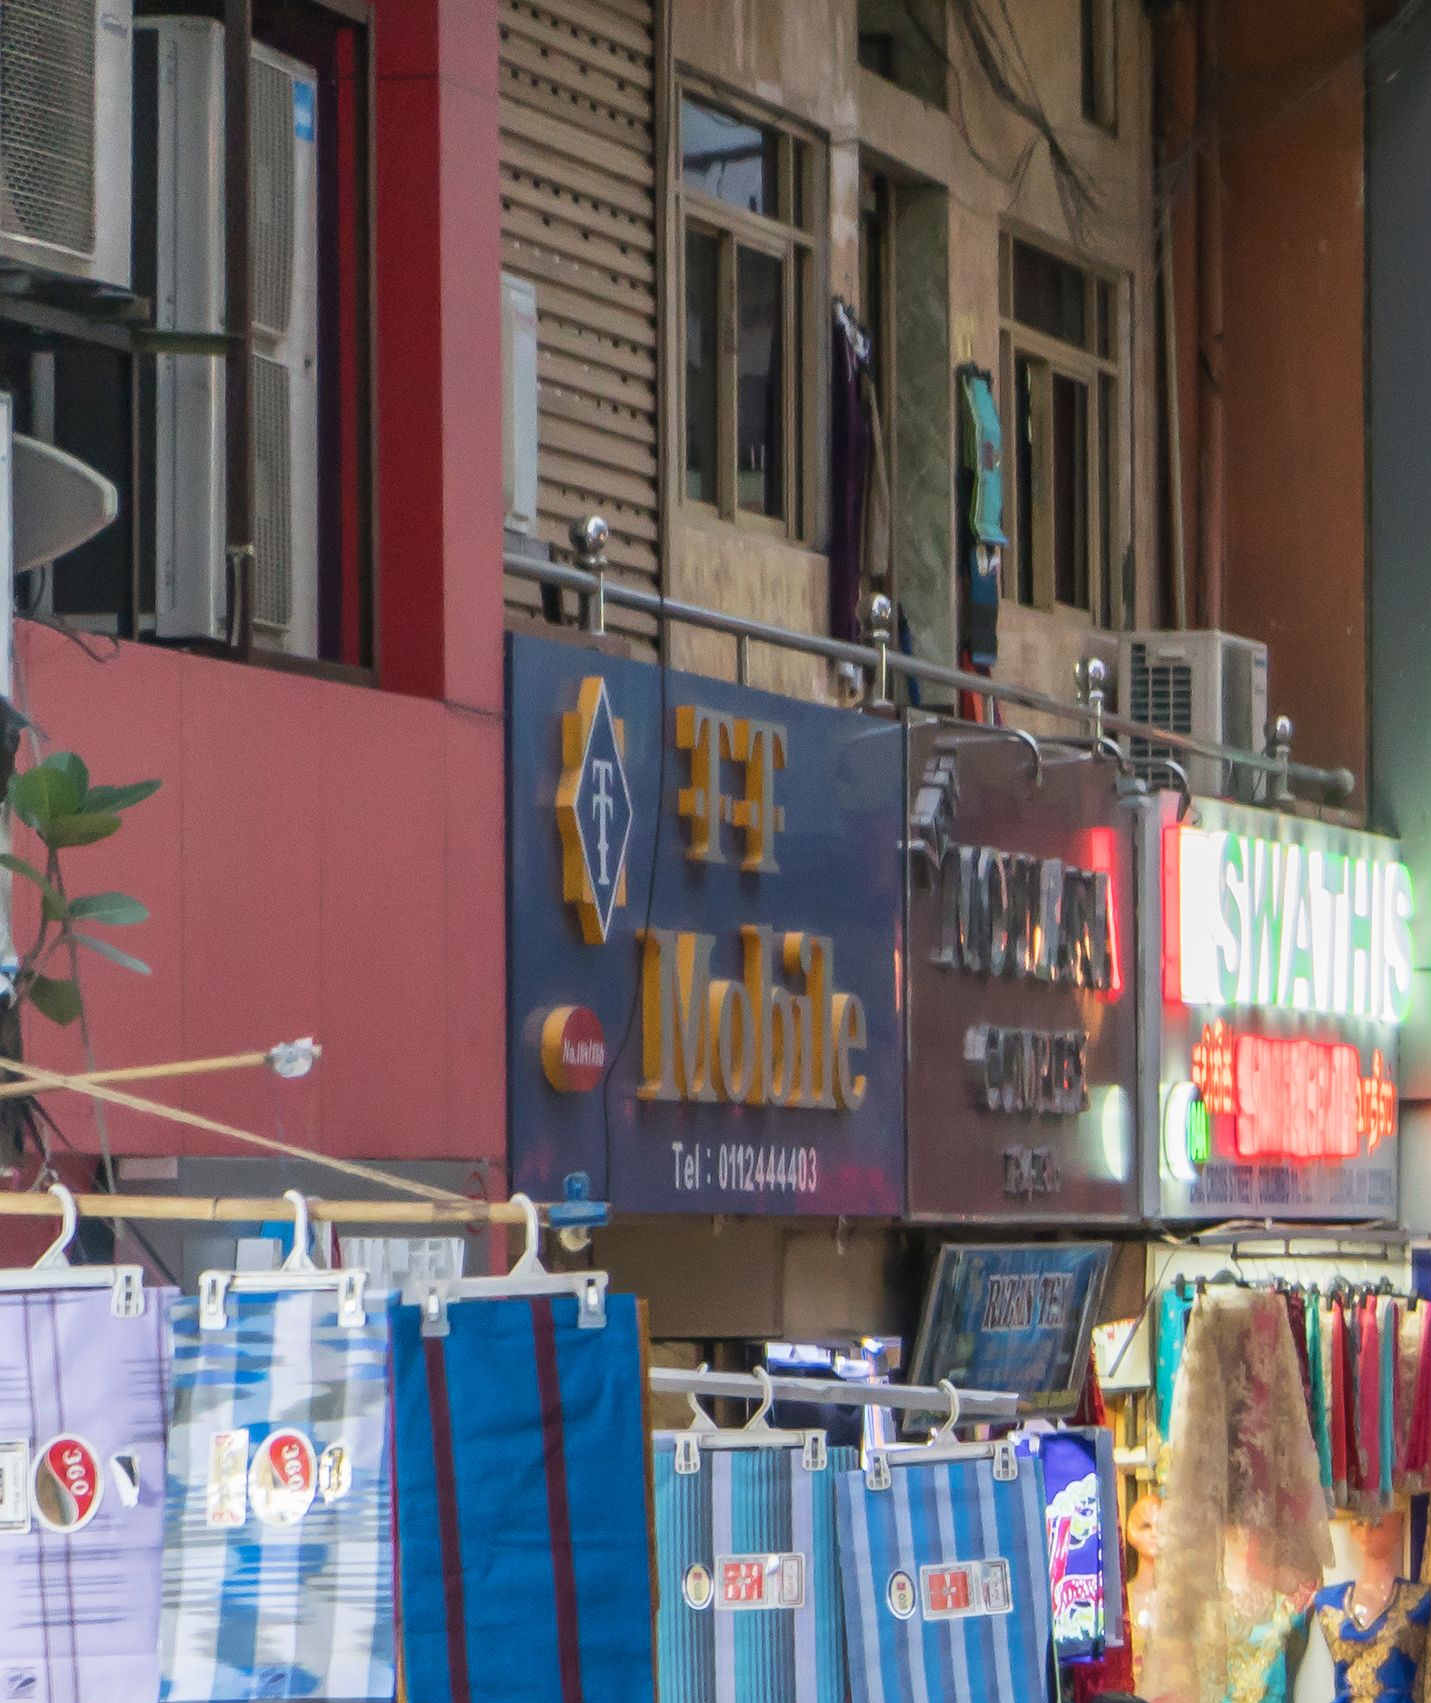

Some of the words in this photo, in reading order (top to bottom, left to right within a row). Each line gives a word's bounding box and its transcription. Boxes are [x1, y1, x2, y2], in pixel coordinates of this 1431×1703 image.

[634, 922, 868, 1114] Mobile
[62, 1447, 89, 1497] 360
[281, 1442, 305, 1492] 360
